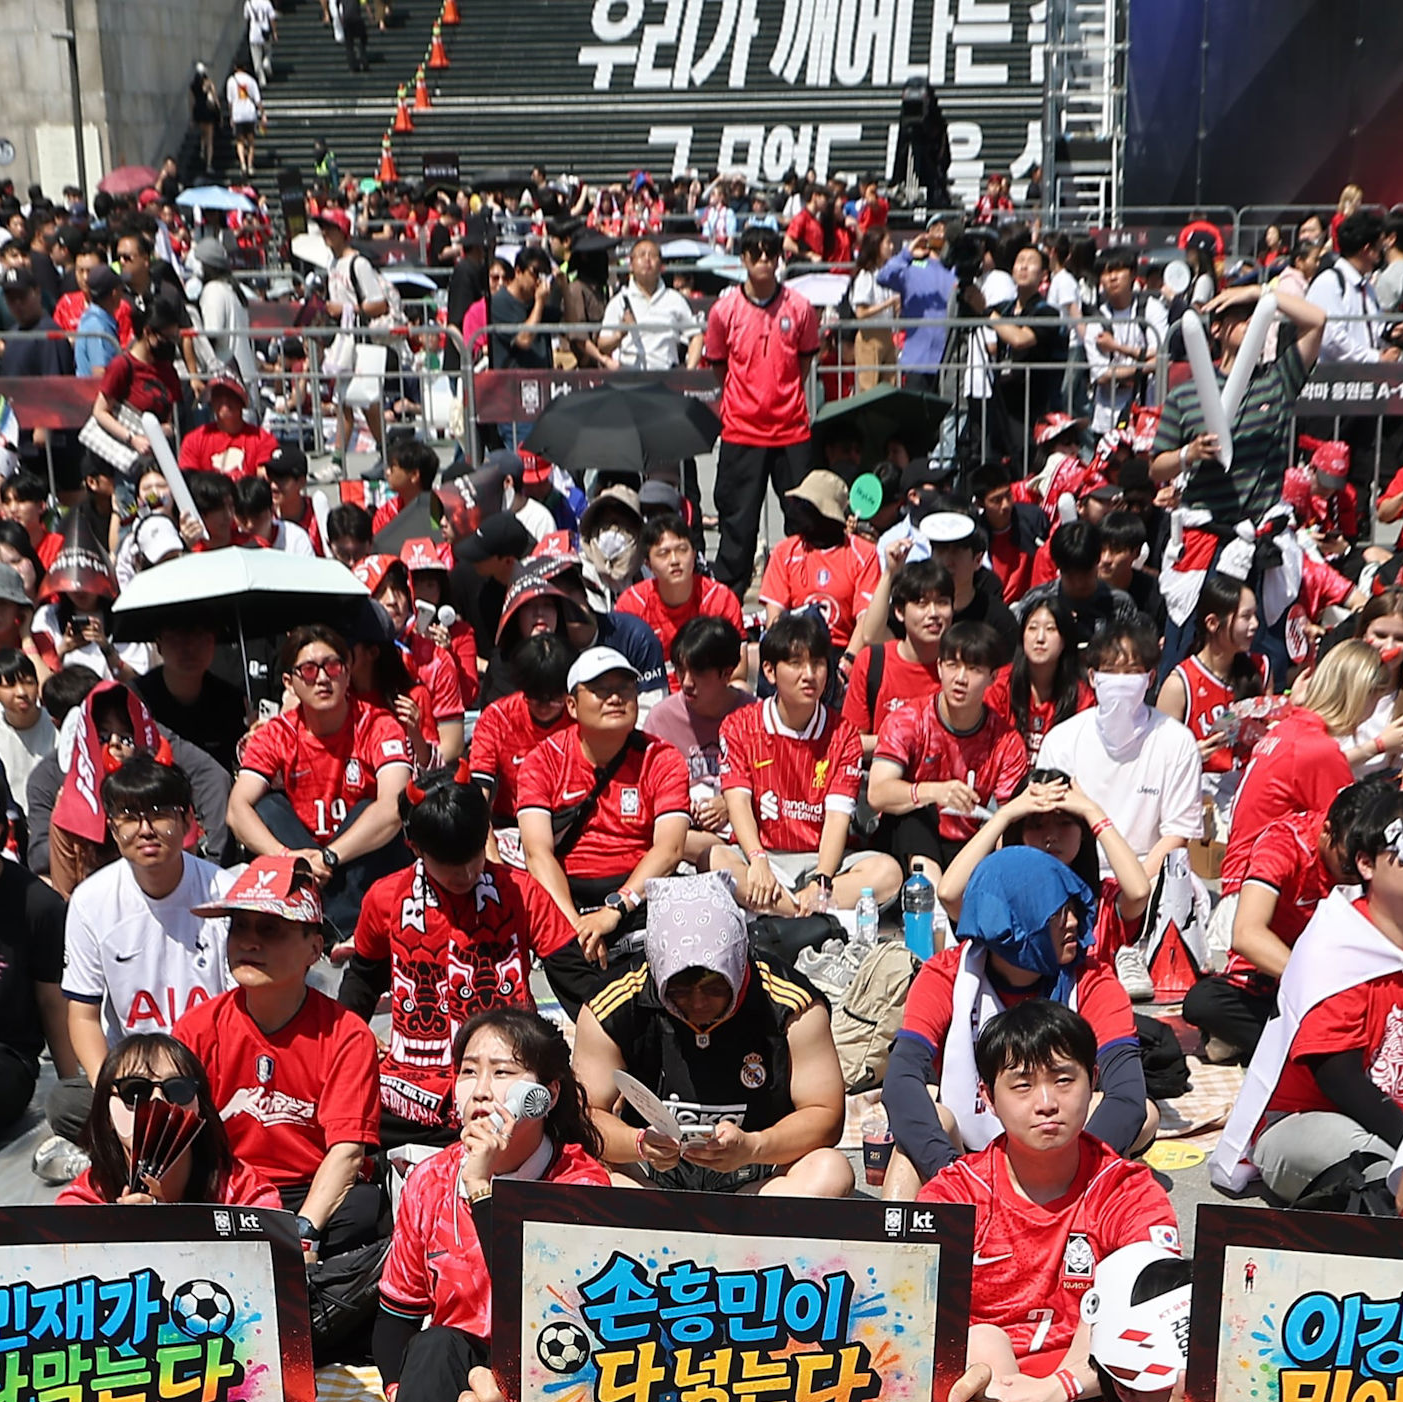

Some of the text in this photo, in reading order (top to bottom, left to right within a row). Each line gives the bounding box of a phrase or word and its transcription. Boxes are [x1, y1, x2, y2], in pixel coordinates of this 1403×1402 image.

[578, 0, 1013, 89] 우리가 깨어나는
[313, 797, 347, 836] 19
[239, 1213, 260, 1229] kt
[912, 1210, 935, 1229] kt
[581, 1254, 848, 1344] 손흥민이
[1027, 1308, 1055, 1353] 7
